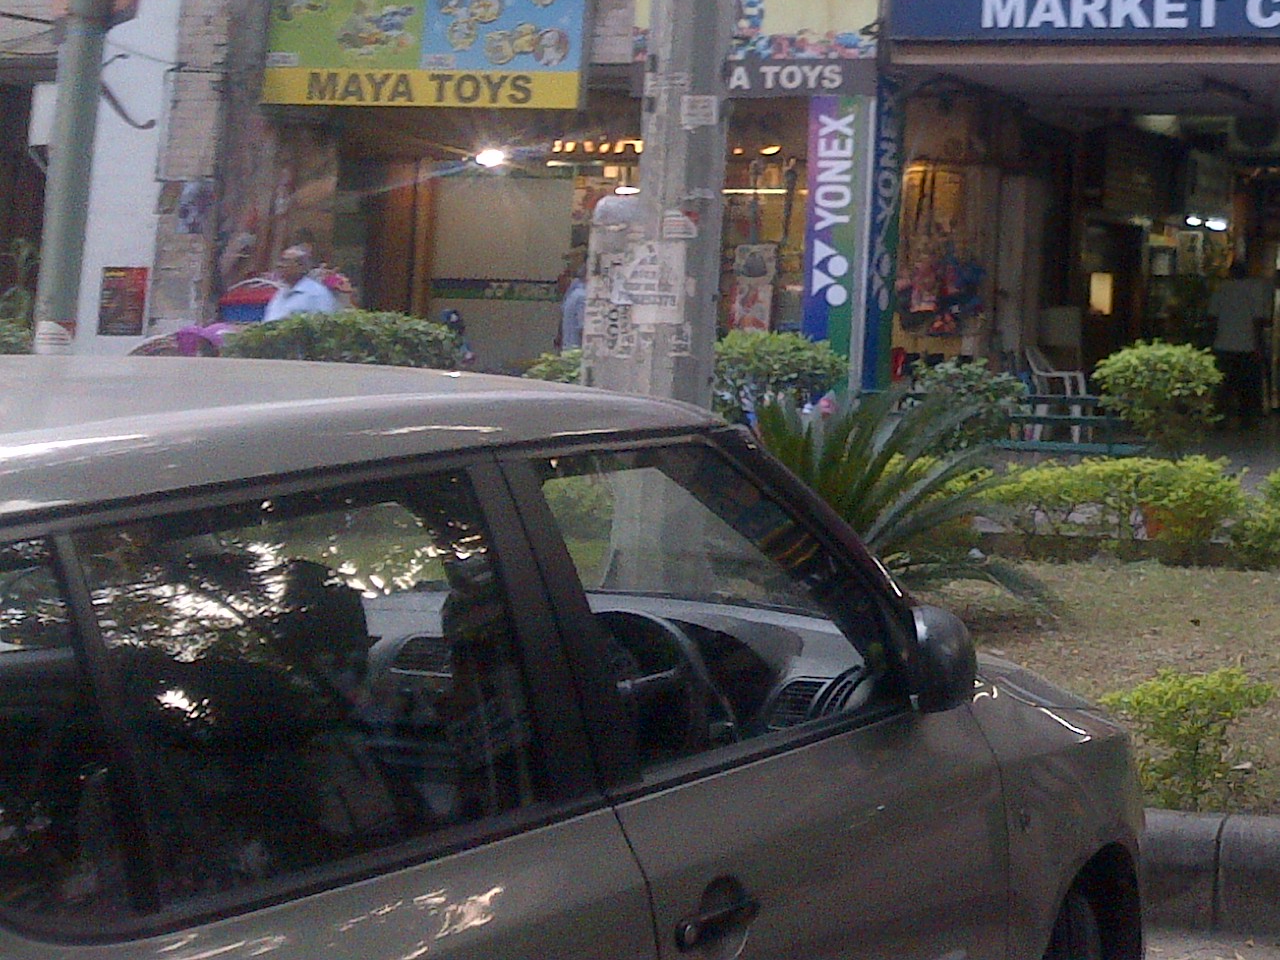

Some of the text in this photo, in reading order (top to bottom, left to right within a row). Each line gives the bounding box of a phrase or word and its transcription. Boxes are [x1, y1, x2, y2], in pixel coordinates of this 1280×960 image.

[306, 72, 534, 105] MAYA TOYS
[759, 65, 844, 90] TOYS
[814, 113, 856, 231] YONEX
